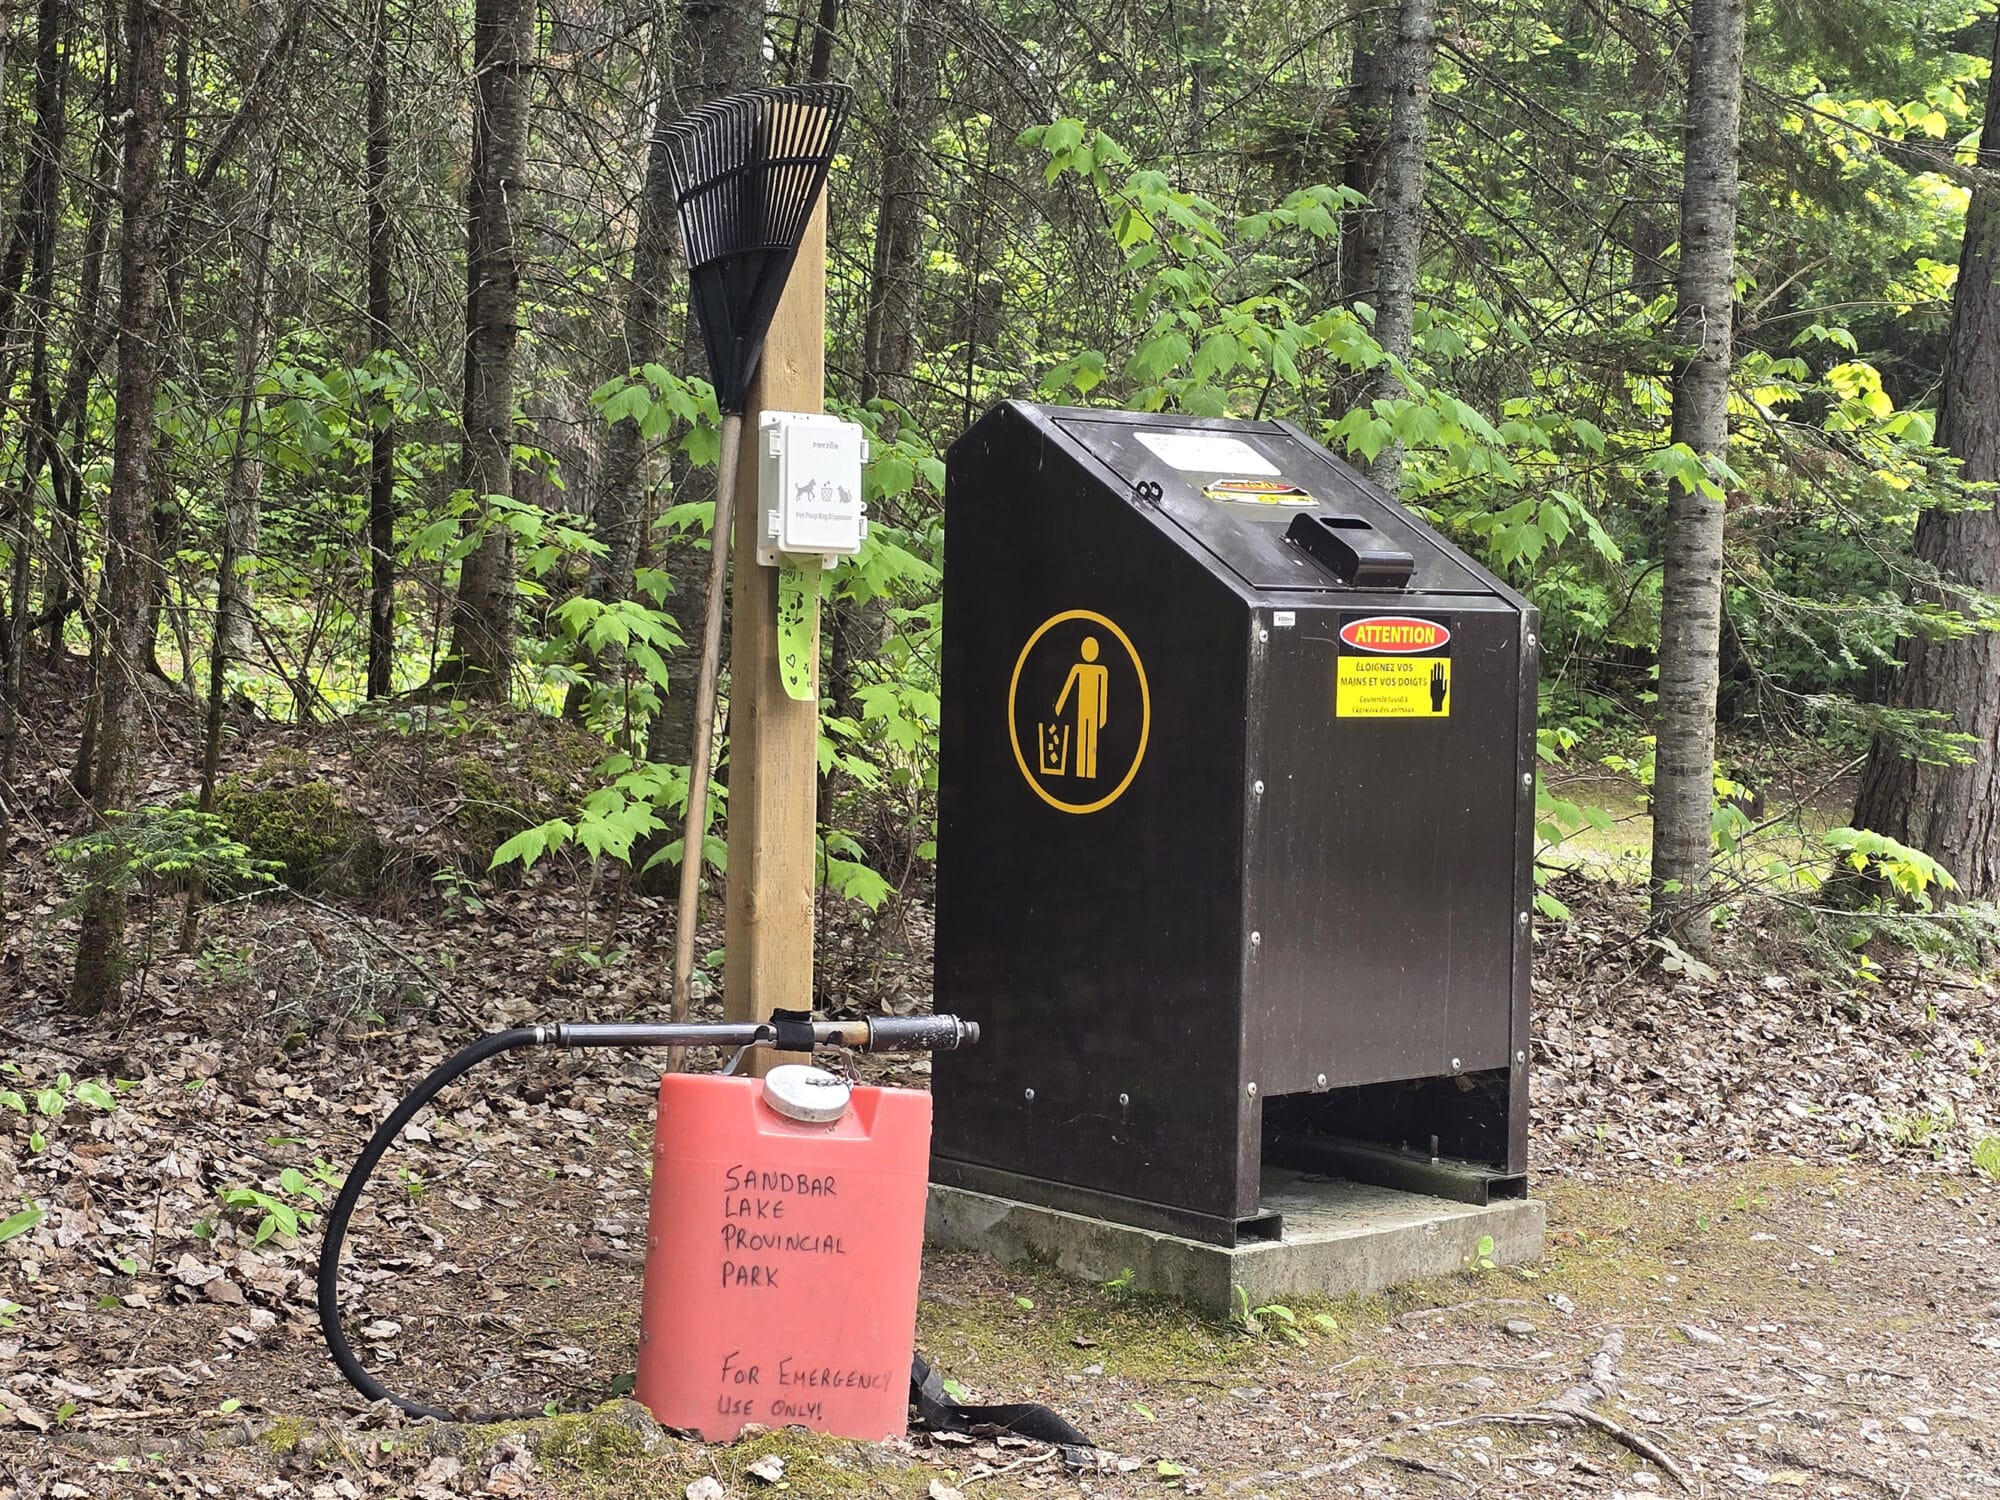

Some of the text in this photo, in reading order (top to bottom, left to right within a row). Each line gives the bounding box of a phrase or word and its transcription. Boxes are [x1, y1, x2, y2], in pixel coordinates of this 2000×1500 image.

[1354, 625, 1436, 644] ATTENTION
[1355, 661, 1414, 672] ÉLOIGNEZ VOS
[1340, 677, 1428, 687] MAINS ET VOS DOIGTS
[724, 1164, 837, 1197] SANDBAR
[725, 1196, 785, 1220] LAKE
[721, 1223, 846, 1254] PROVINCIAL
[722, 1260, 779, 1289] PARK
[721, 1351, 893, 1393] FOR EMERGENCY
[717, 1394, 823, 1421] USE ONLY!
